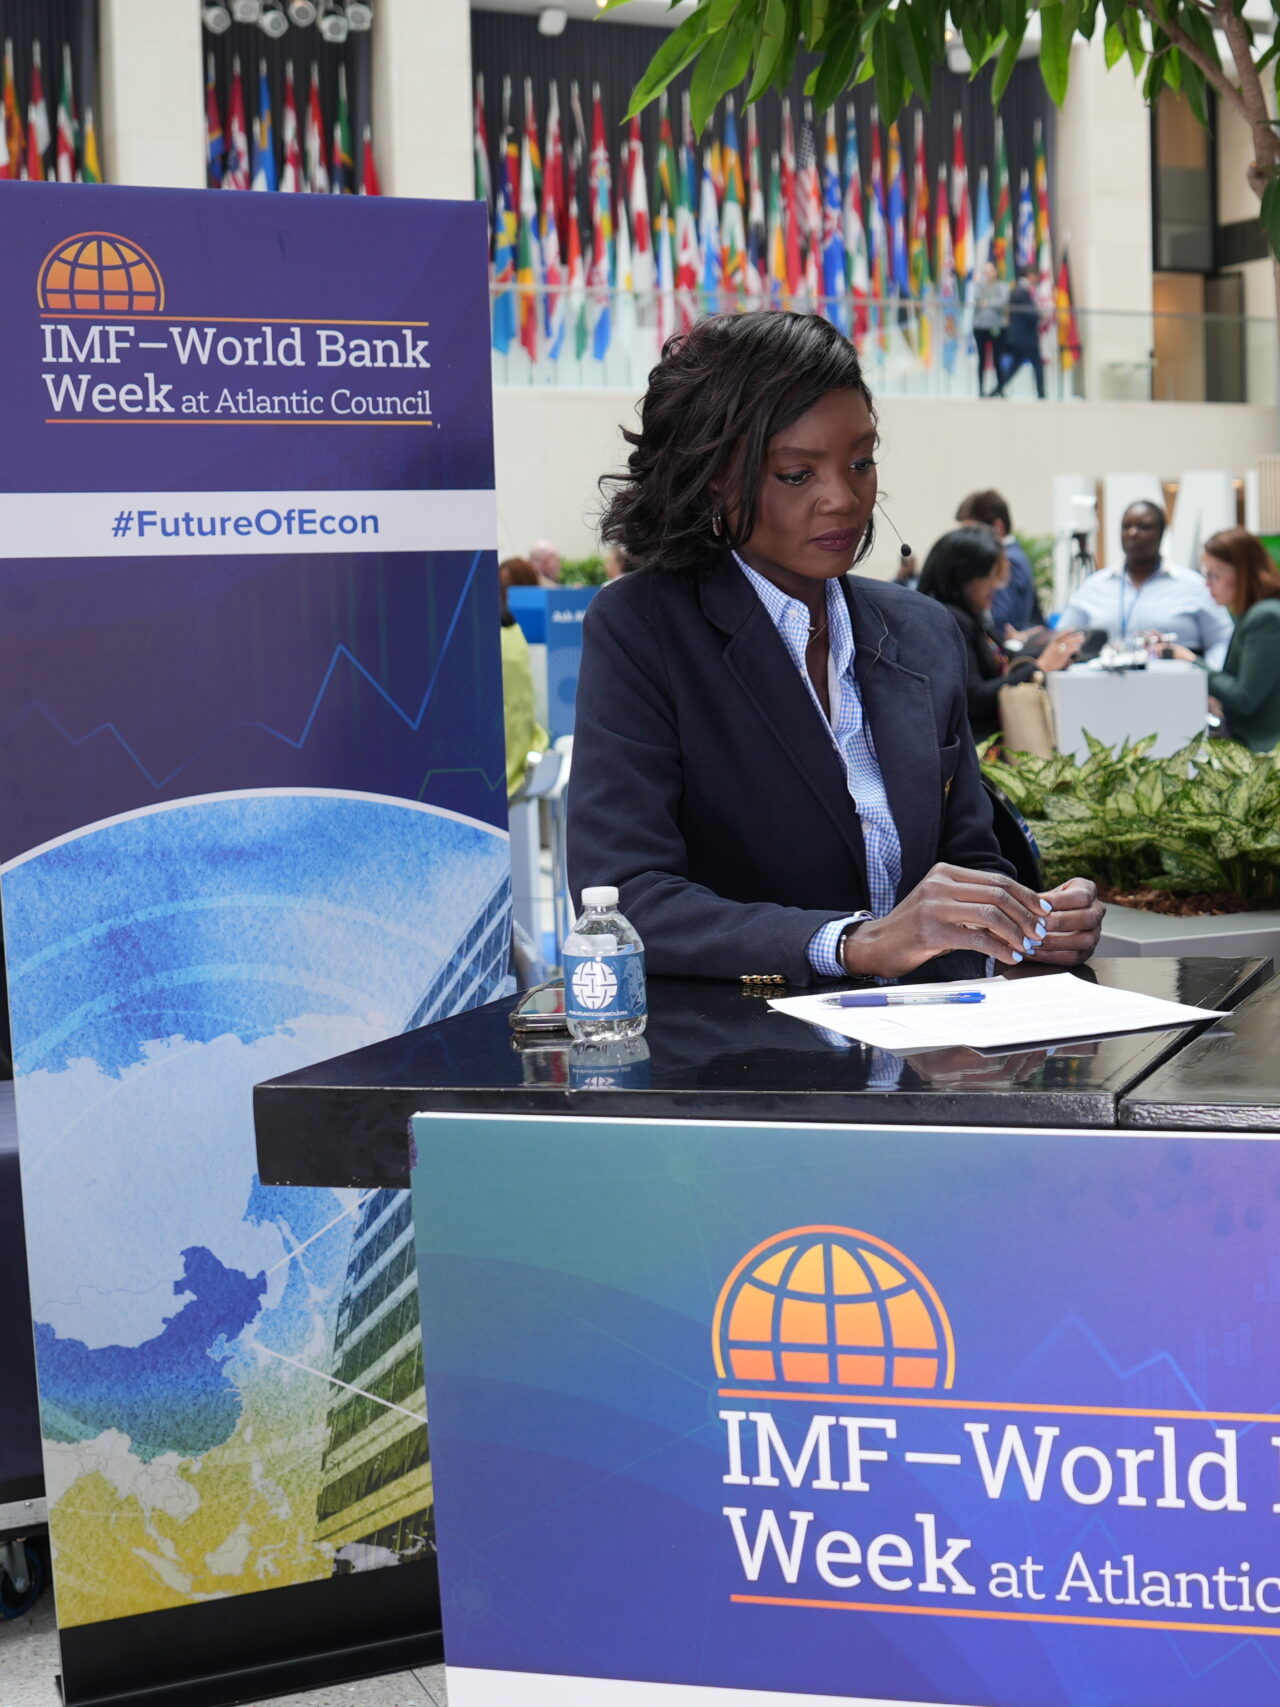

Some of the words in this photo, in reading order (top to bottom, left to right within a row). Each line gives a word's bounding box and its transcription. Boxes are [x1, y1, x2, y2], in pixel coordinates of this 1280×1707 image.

[316, 329, 431, 368] Bank
[41, 372, 176, 413] Week
[181, 391, 210, 414] at
[214, 388, 324, 415] Atlantic
[330, 389, 432, 415] Council
[111, 508, 379, 538] #FutureOfEcon
[722, 1505, 976, 1595] Week
[988, 1555, 1046, 1601] at
